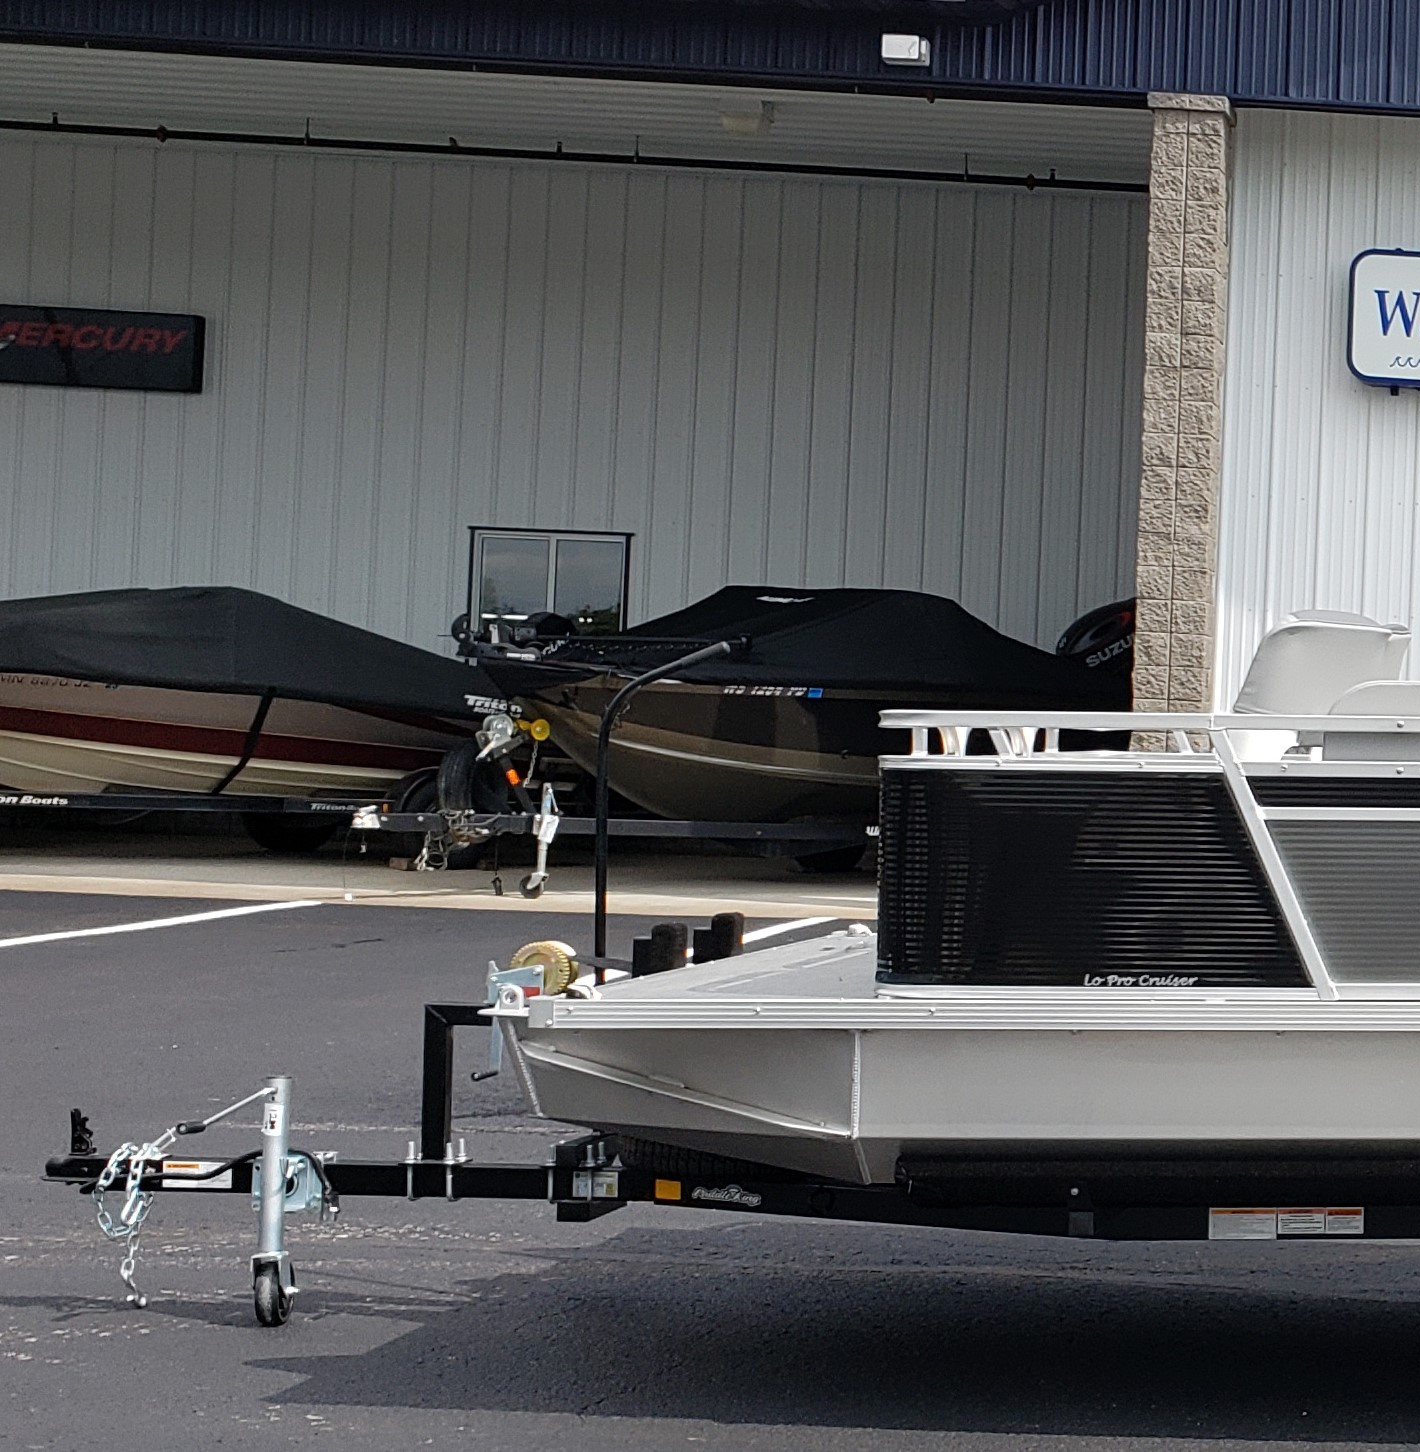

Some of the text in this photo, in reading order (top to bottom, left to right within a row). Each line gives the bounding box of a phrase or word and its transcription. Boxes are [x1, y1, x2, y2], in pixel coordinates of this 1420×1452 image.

[20, 795, 69, 805] Boats
[1084, 973, 1199, 987] Lo Pro Cruiser
